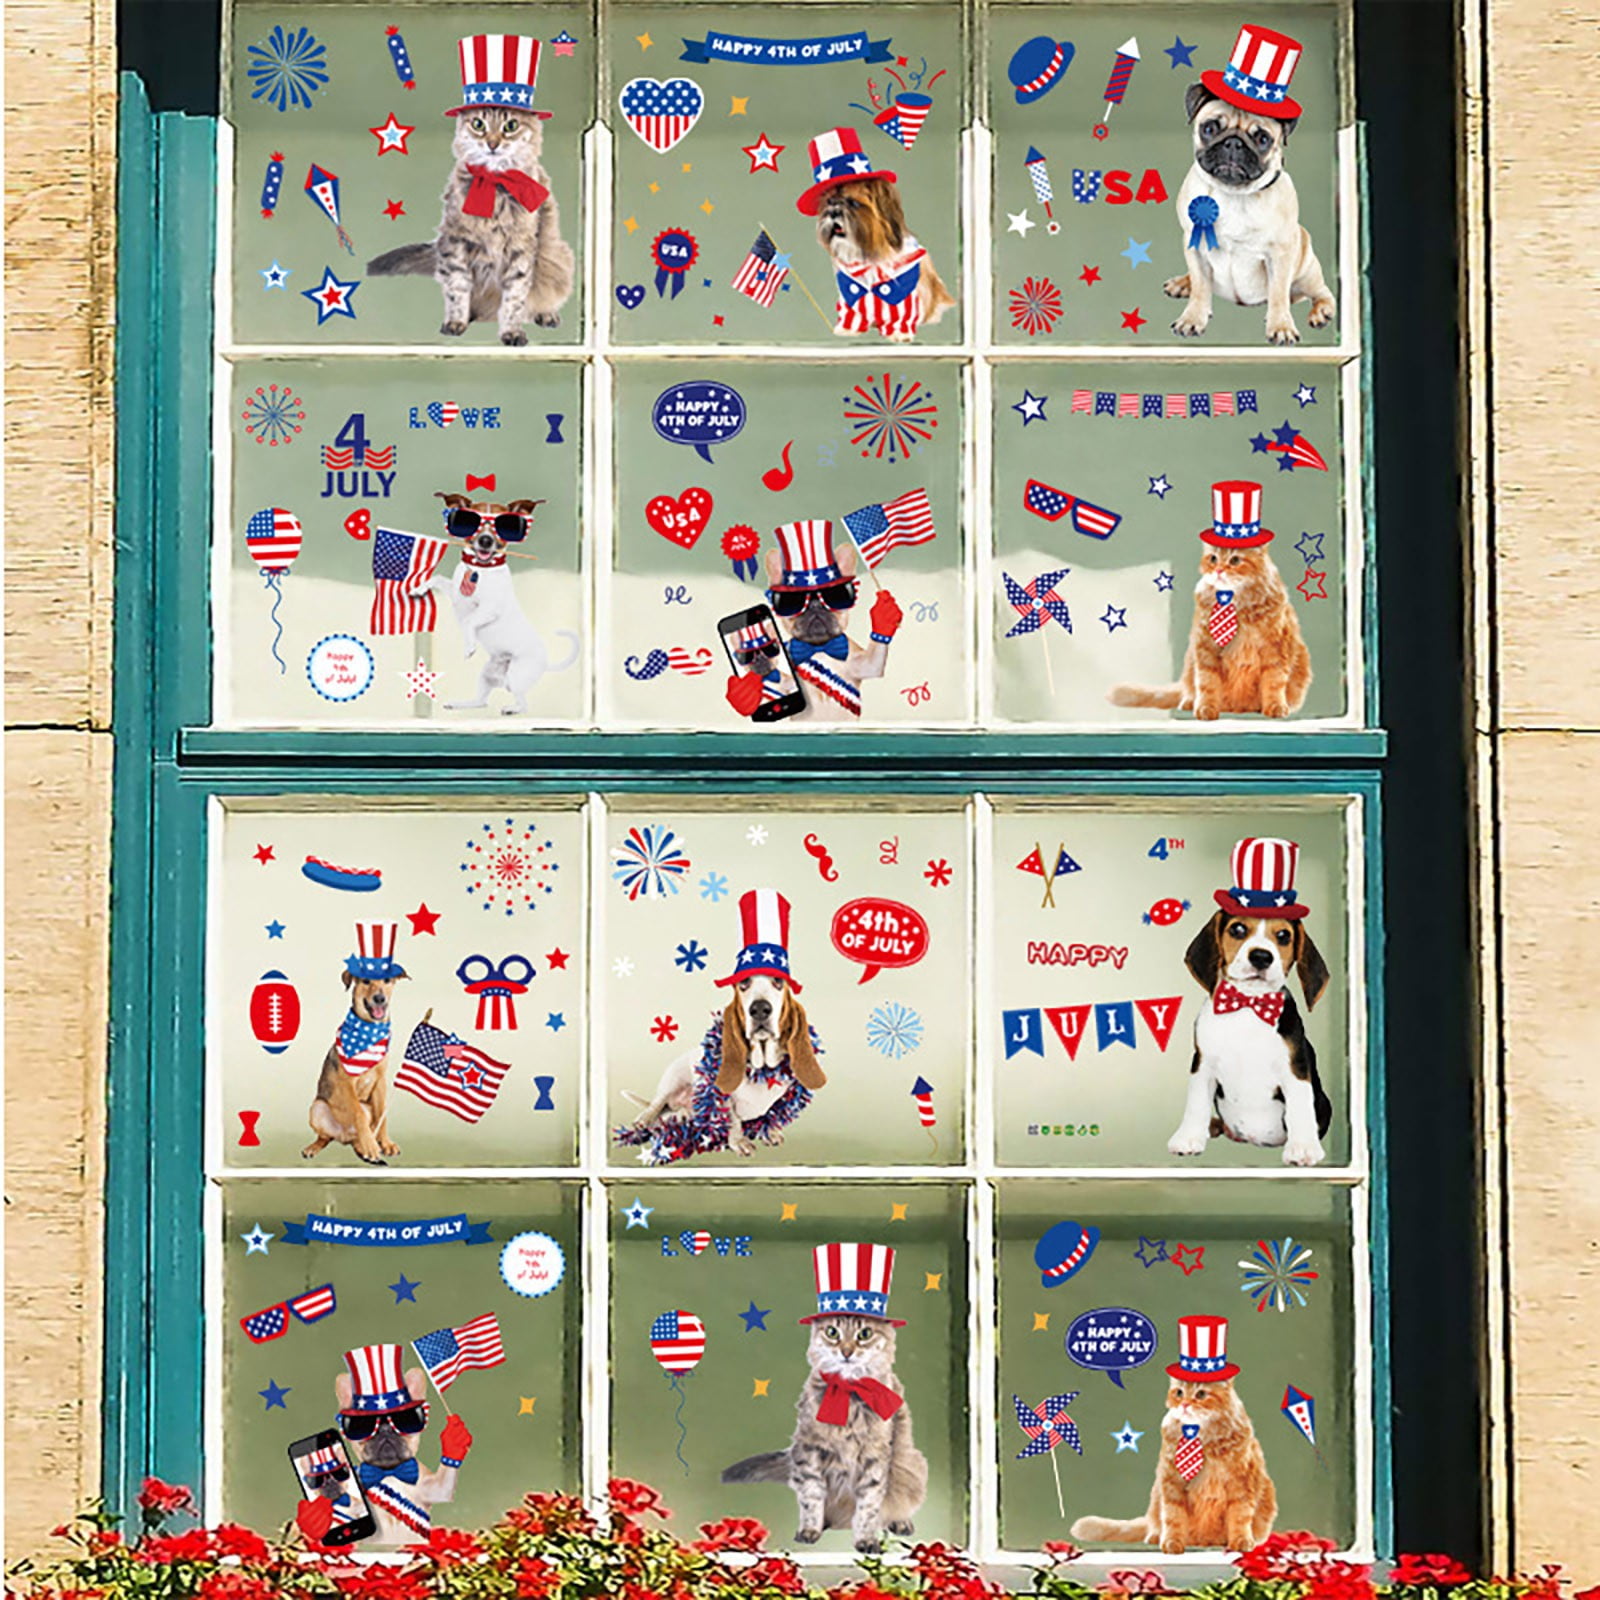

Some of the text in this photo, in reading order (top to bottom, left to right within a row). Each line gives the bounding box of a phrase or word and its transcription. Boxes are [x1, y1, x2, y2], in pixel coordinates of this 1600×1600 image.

[712, 38, 863, 58] HAPPY 4TH OF JULY
[1071, 168, 1169, 205] USA
[661, 243, 689, 258] USA
[675, 401, 720, 413] HAPPY
[659, 415, 740, 427] 4TH OF JULY
[334, 413, 371, 467] 4
[320, 471, 397, 498] JULY
[662, 507, 702, 528] USA
[858, 909, 899, 934] 4th
[841, 932, 915, 956] OF JULY
[1027, 941, 1129, 970] HAPPY
[1012, 1004, 1170, 1042] JULY
[312, 1220, 463, 1240] HAPPY 4TH OF JULY
[1087, 1326, 1132, 1339] HAPPY
[1071, 1341, 1151, 1353] 4TH OF JULY
